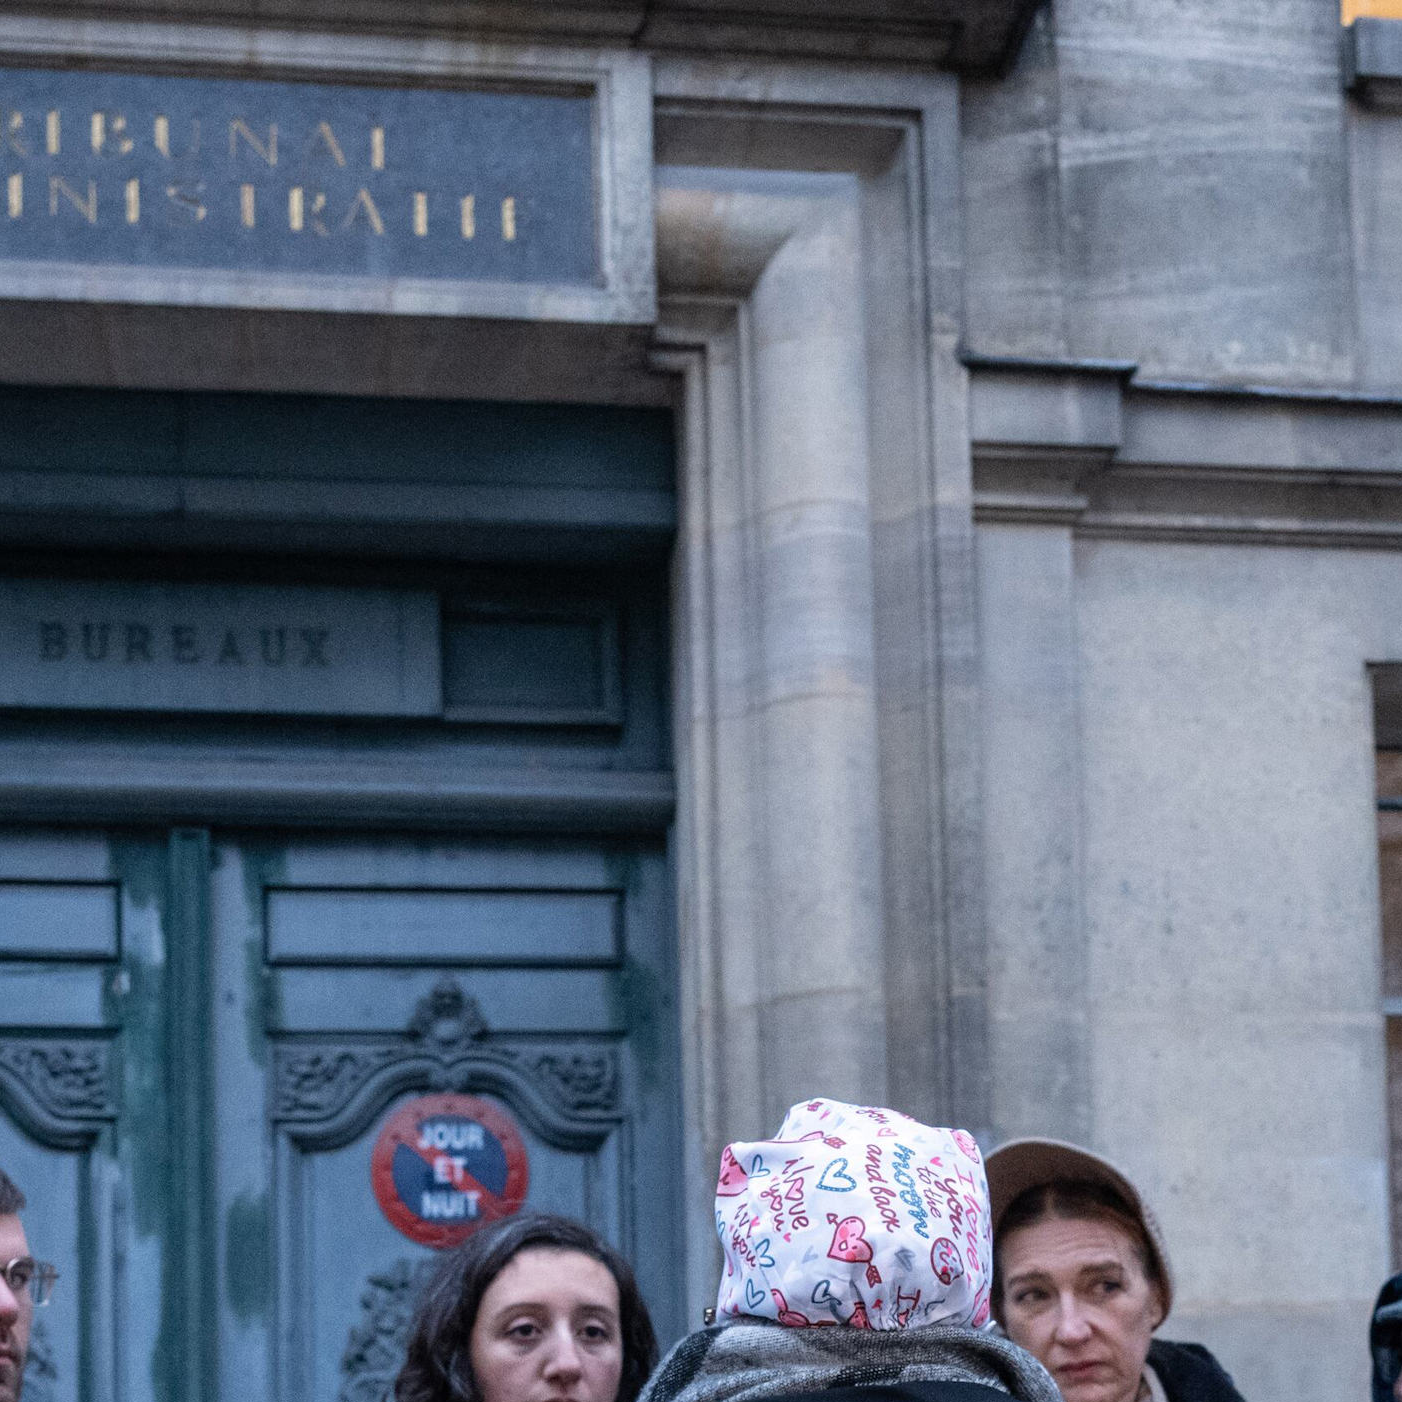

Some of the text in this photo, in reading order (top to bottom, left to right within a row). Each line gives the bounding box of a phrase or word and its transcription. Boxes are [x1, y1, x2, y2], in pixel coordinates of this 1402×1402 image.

[37, 618, 334, 669] BUREAUX
[417, 1122, 485, 1150] JOUR
[433, 1156, 467, 1183] ET
[864, 1143, 889, 1184] and
[421, 1190, 481, 1219] NUIT
